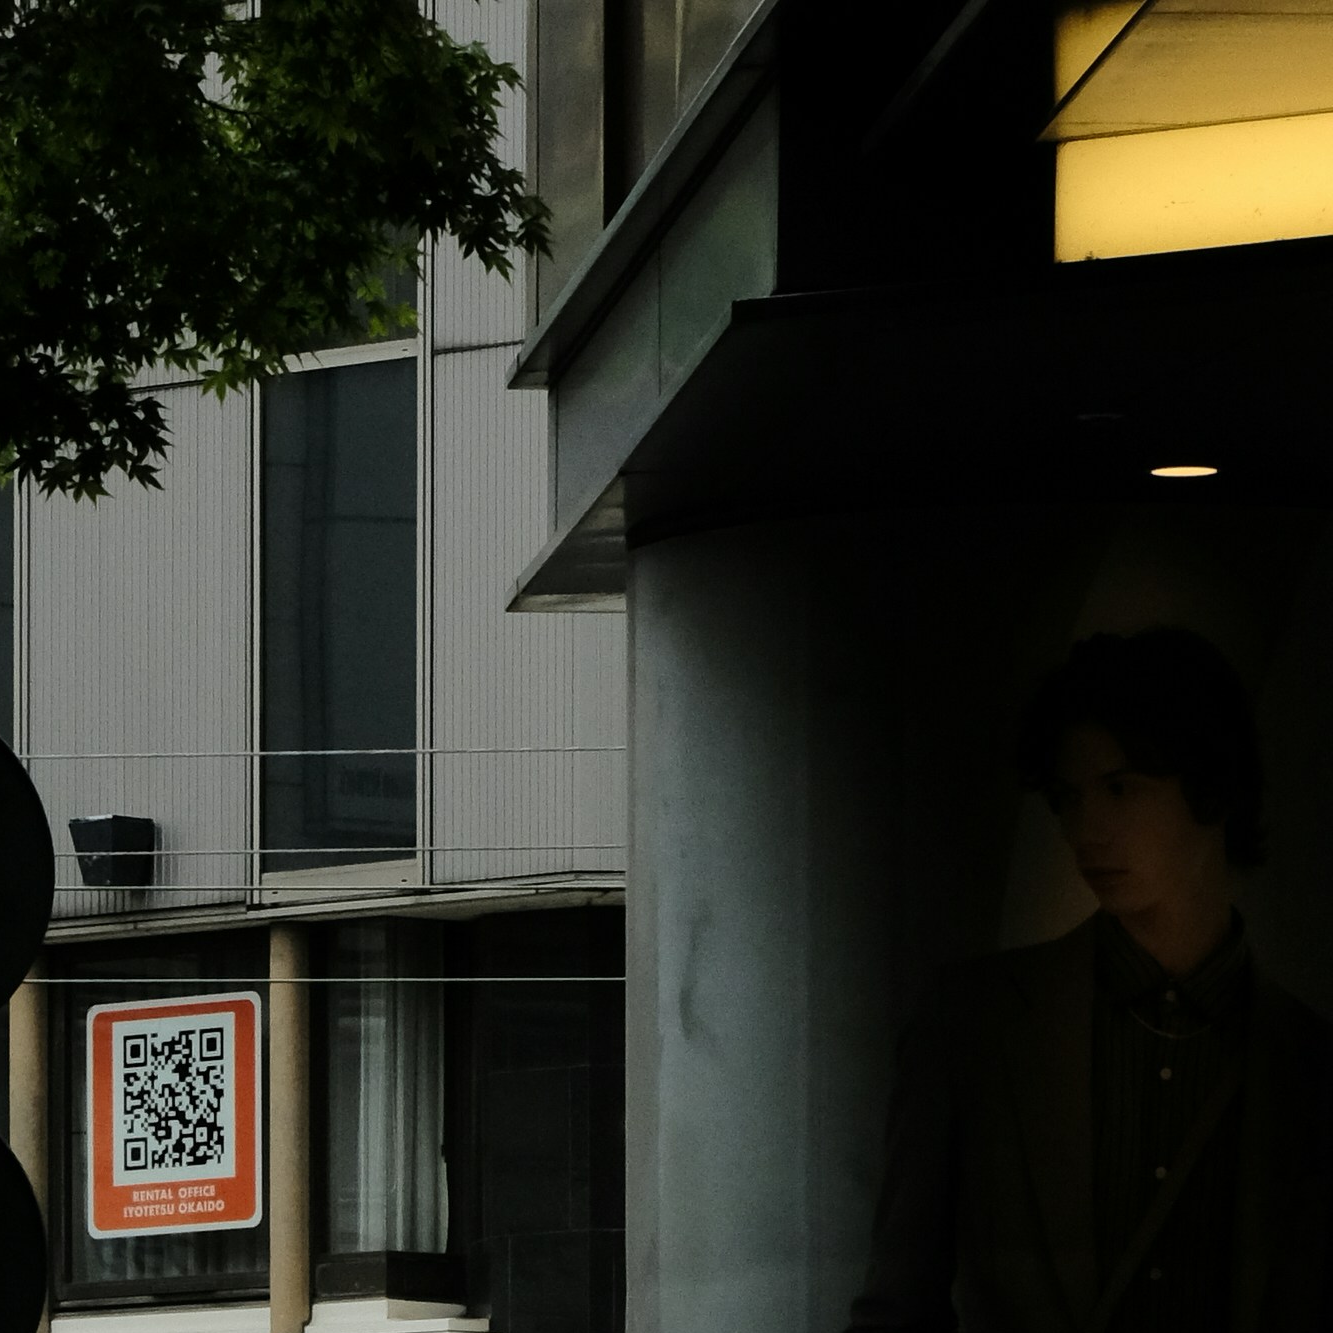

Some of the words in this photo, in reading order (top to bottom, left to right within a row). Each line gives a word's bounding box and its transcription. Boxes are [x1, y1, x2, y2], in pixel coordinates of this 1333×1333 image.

[133, 1189, 173, 1201] RENTAL
[178, 1185, 215, 1198] OFFICE
[123, 1203, 174, 1218] IYOTETSU
[178, 1200, 225, 1214] OKAIDO
